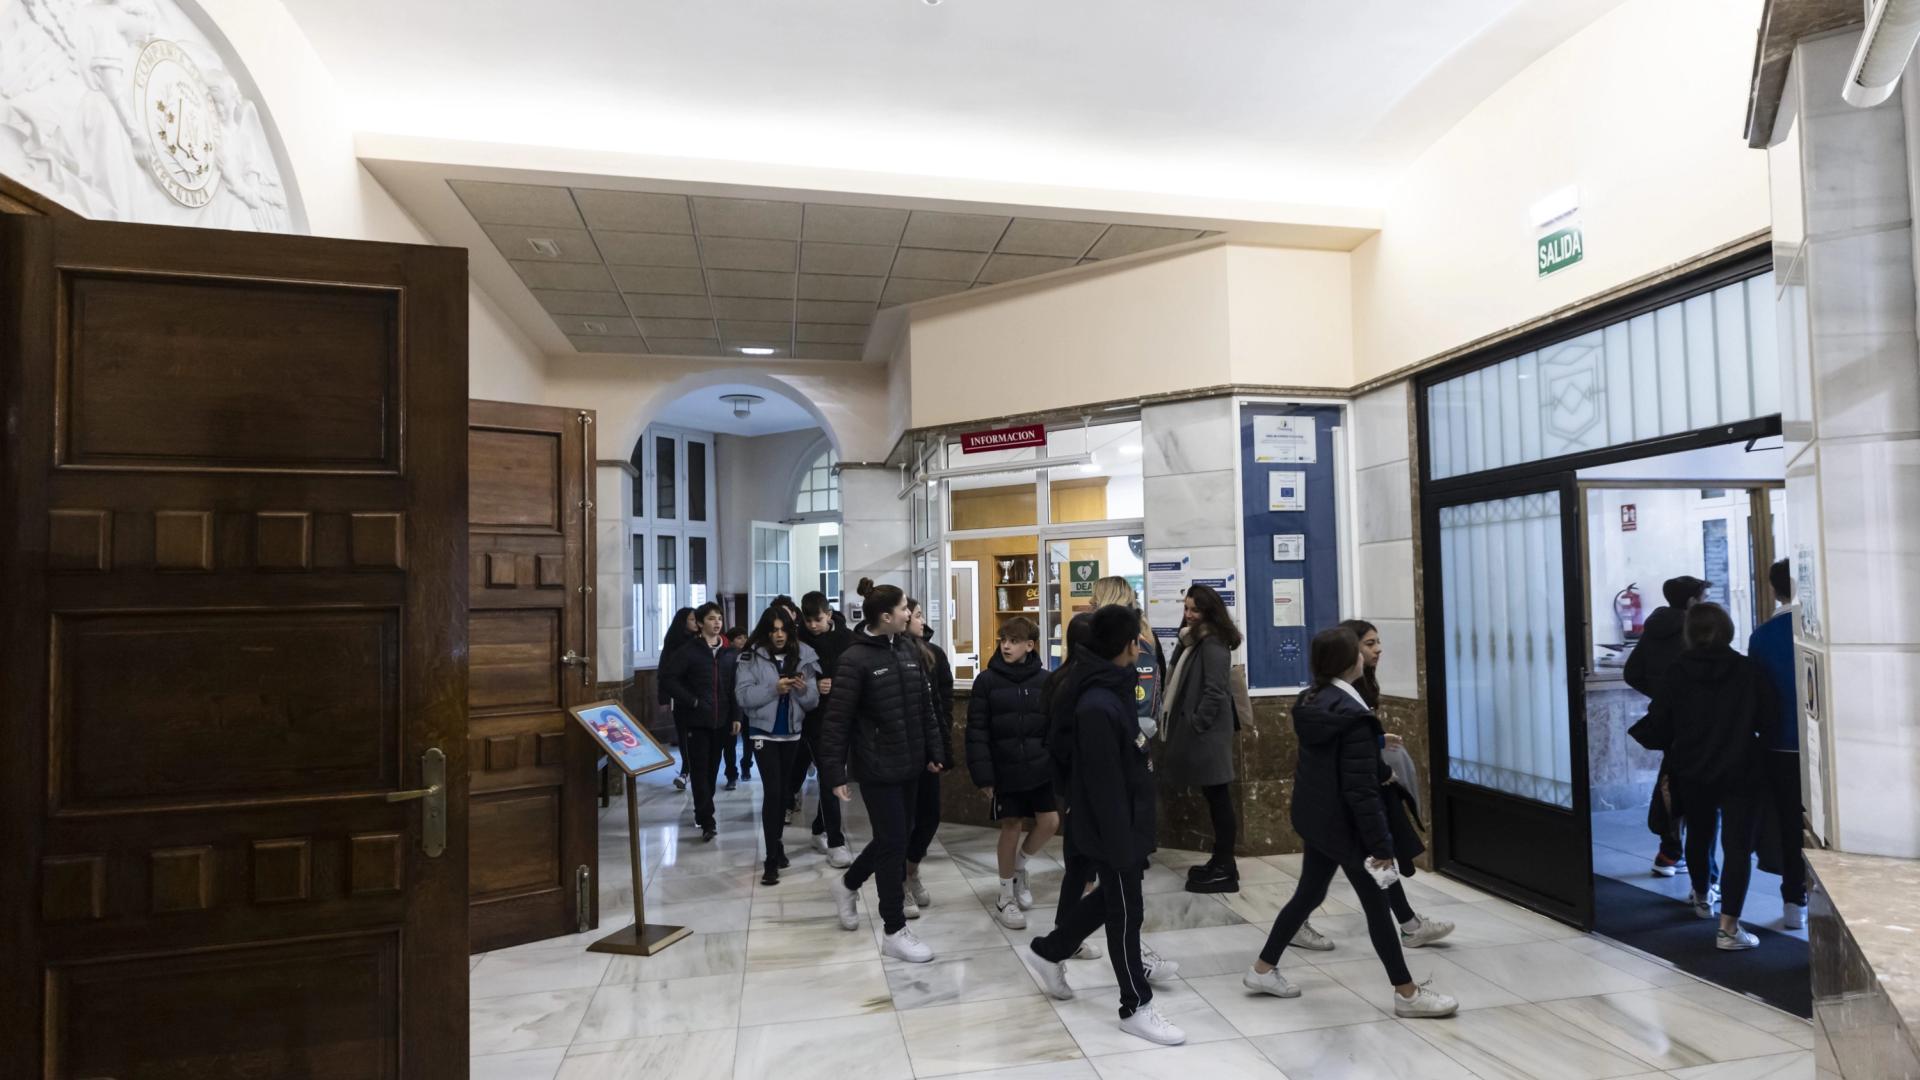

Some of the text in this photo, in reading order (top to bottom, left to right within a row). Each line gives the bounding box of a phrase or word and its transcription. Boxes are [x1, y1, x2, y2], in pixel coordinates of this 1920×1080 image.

[1540, 231, 1581, 269] SALIDA
[971, 430, 1035, 446] INFORMACION
[1076, 582, 1092, 591] DEA
